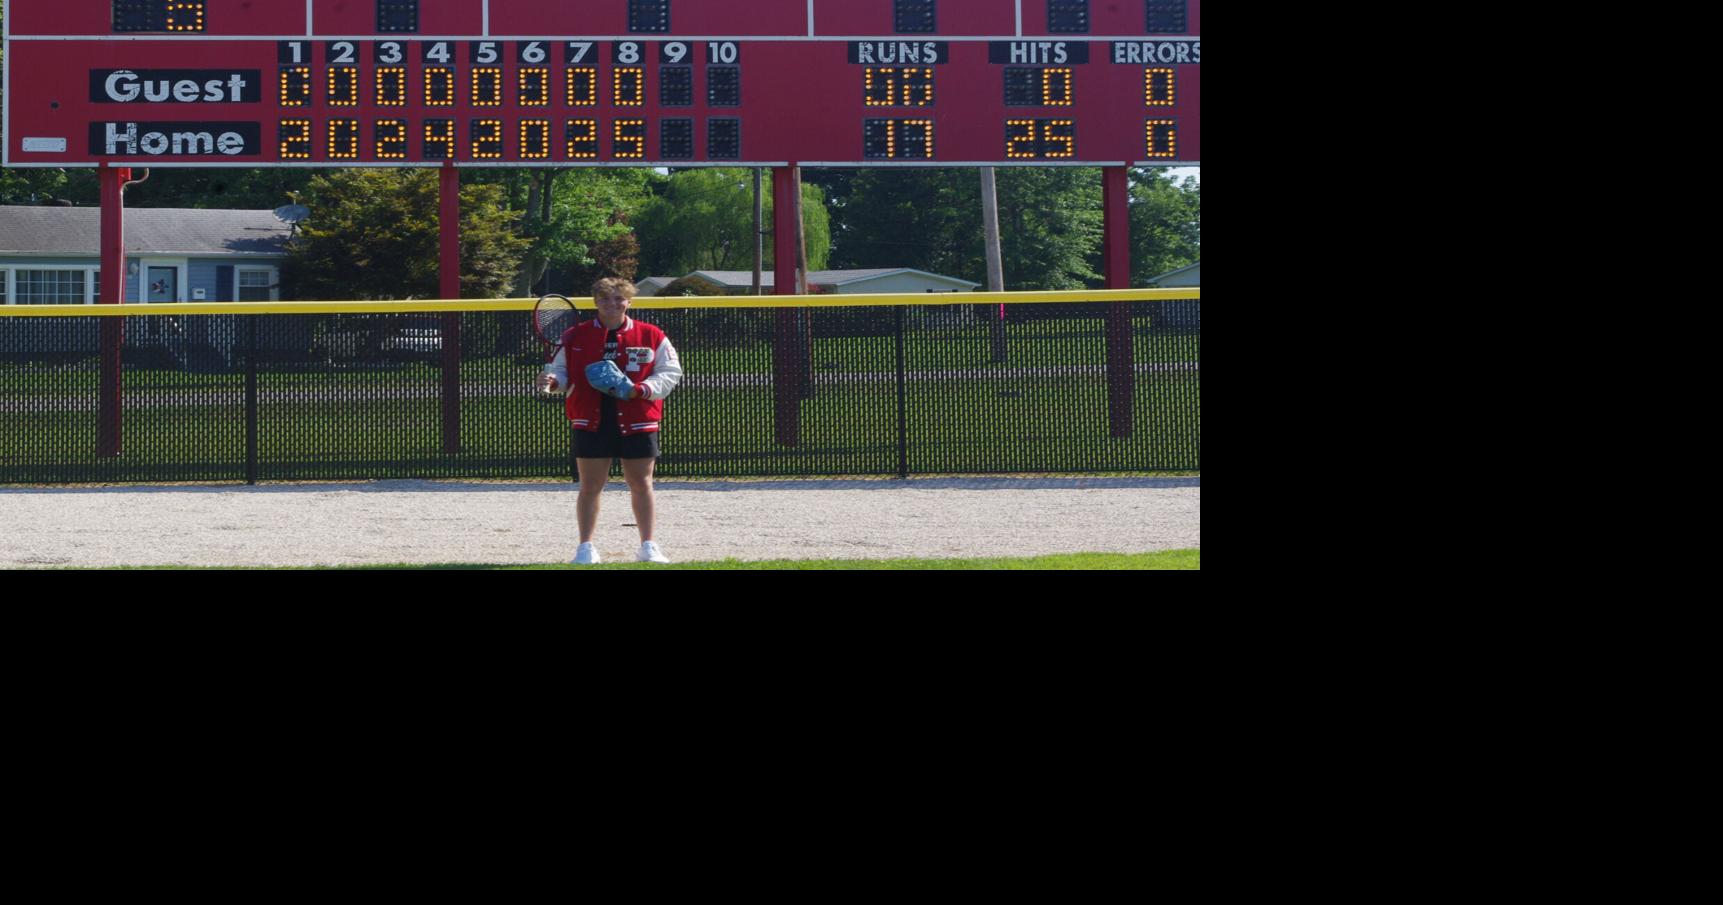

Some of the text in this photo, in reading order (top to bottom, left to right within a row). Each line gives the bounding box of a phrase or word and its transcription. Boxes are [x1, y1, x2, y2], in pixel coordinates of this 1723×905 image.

[289, 41, 736, 63] 1 2 3 4 5 6 7 8 9 10
[859, 43, 937, 63] RUNS
[1011, 43, 1067, 63] HITS
[1116, 43, 1200, 62] ERRORS
[106, 70, 245, 102] Guest
[1043, 69, 1071, 105] 0
[1146, 69, 1173, 105] 0
[106, 123, 243, 155] Home
[281, 120, 642, 157] 2 0 2 4 2 0 2 5
[888, 120, 932, 157] 17
[1008, 120, 1072, 157] 25
[1147, 121, 1174, 156] 0
